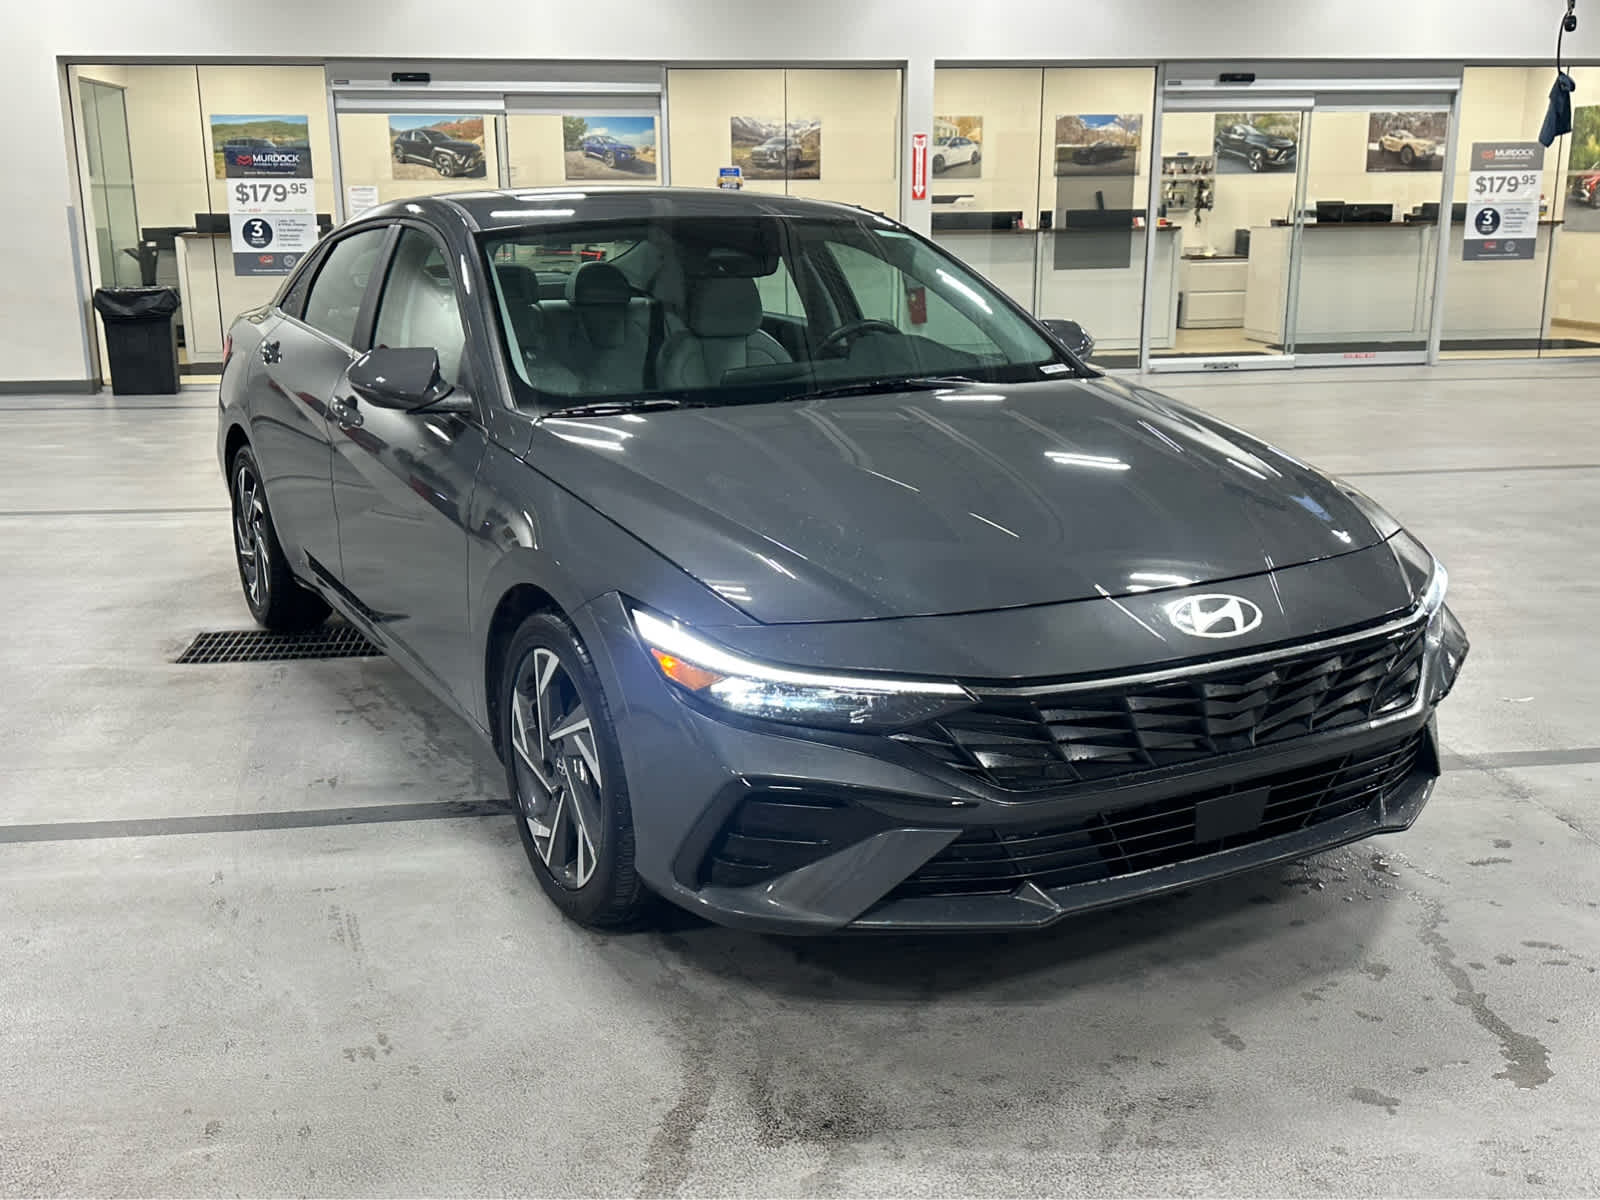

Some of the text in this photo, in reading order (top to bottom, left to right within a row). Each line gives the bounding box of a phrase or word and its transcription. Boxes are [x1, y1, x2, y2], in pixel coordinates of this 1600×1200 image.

[252, 154, 300, 163] MURDOCK
[1482, 210, 1493, 225] 3
[251, 220, 264, 237] 3
